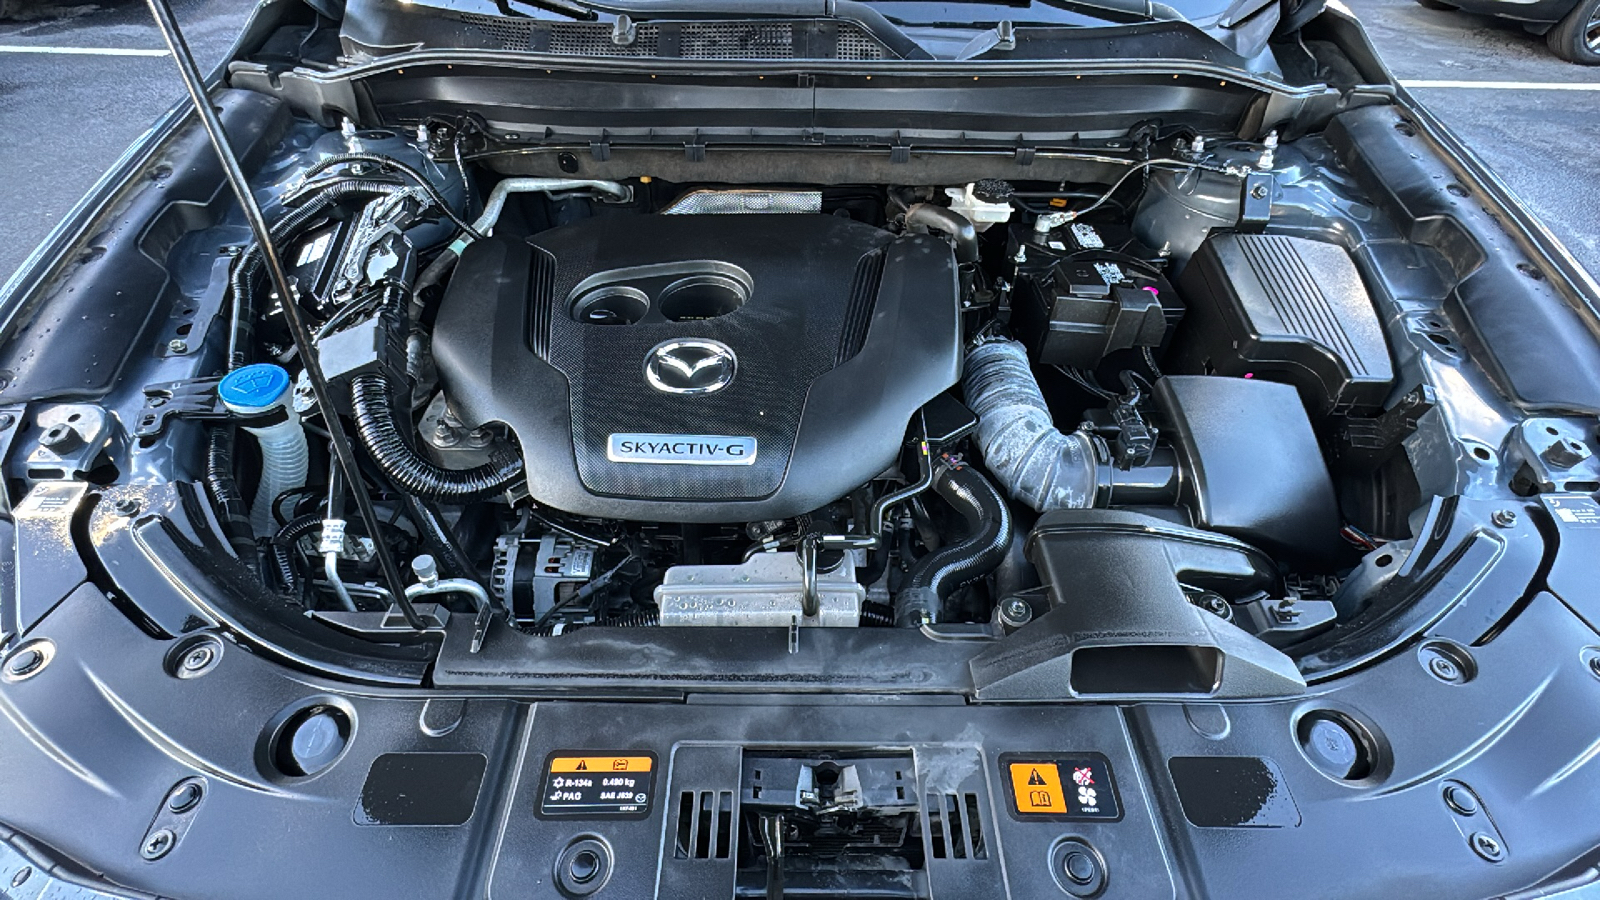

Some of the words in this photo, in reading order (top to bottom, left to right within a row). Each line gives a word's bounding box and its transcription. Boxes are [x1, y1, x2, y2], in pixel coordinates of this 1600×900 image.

[620, 441, 745, 456] SKYACTIV-G
[565, 779, 593, 787] R-134a
[624, 778, 635, 787] kg
[562, 791, 582, 801] PAG
